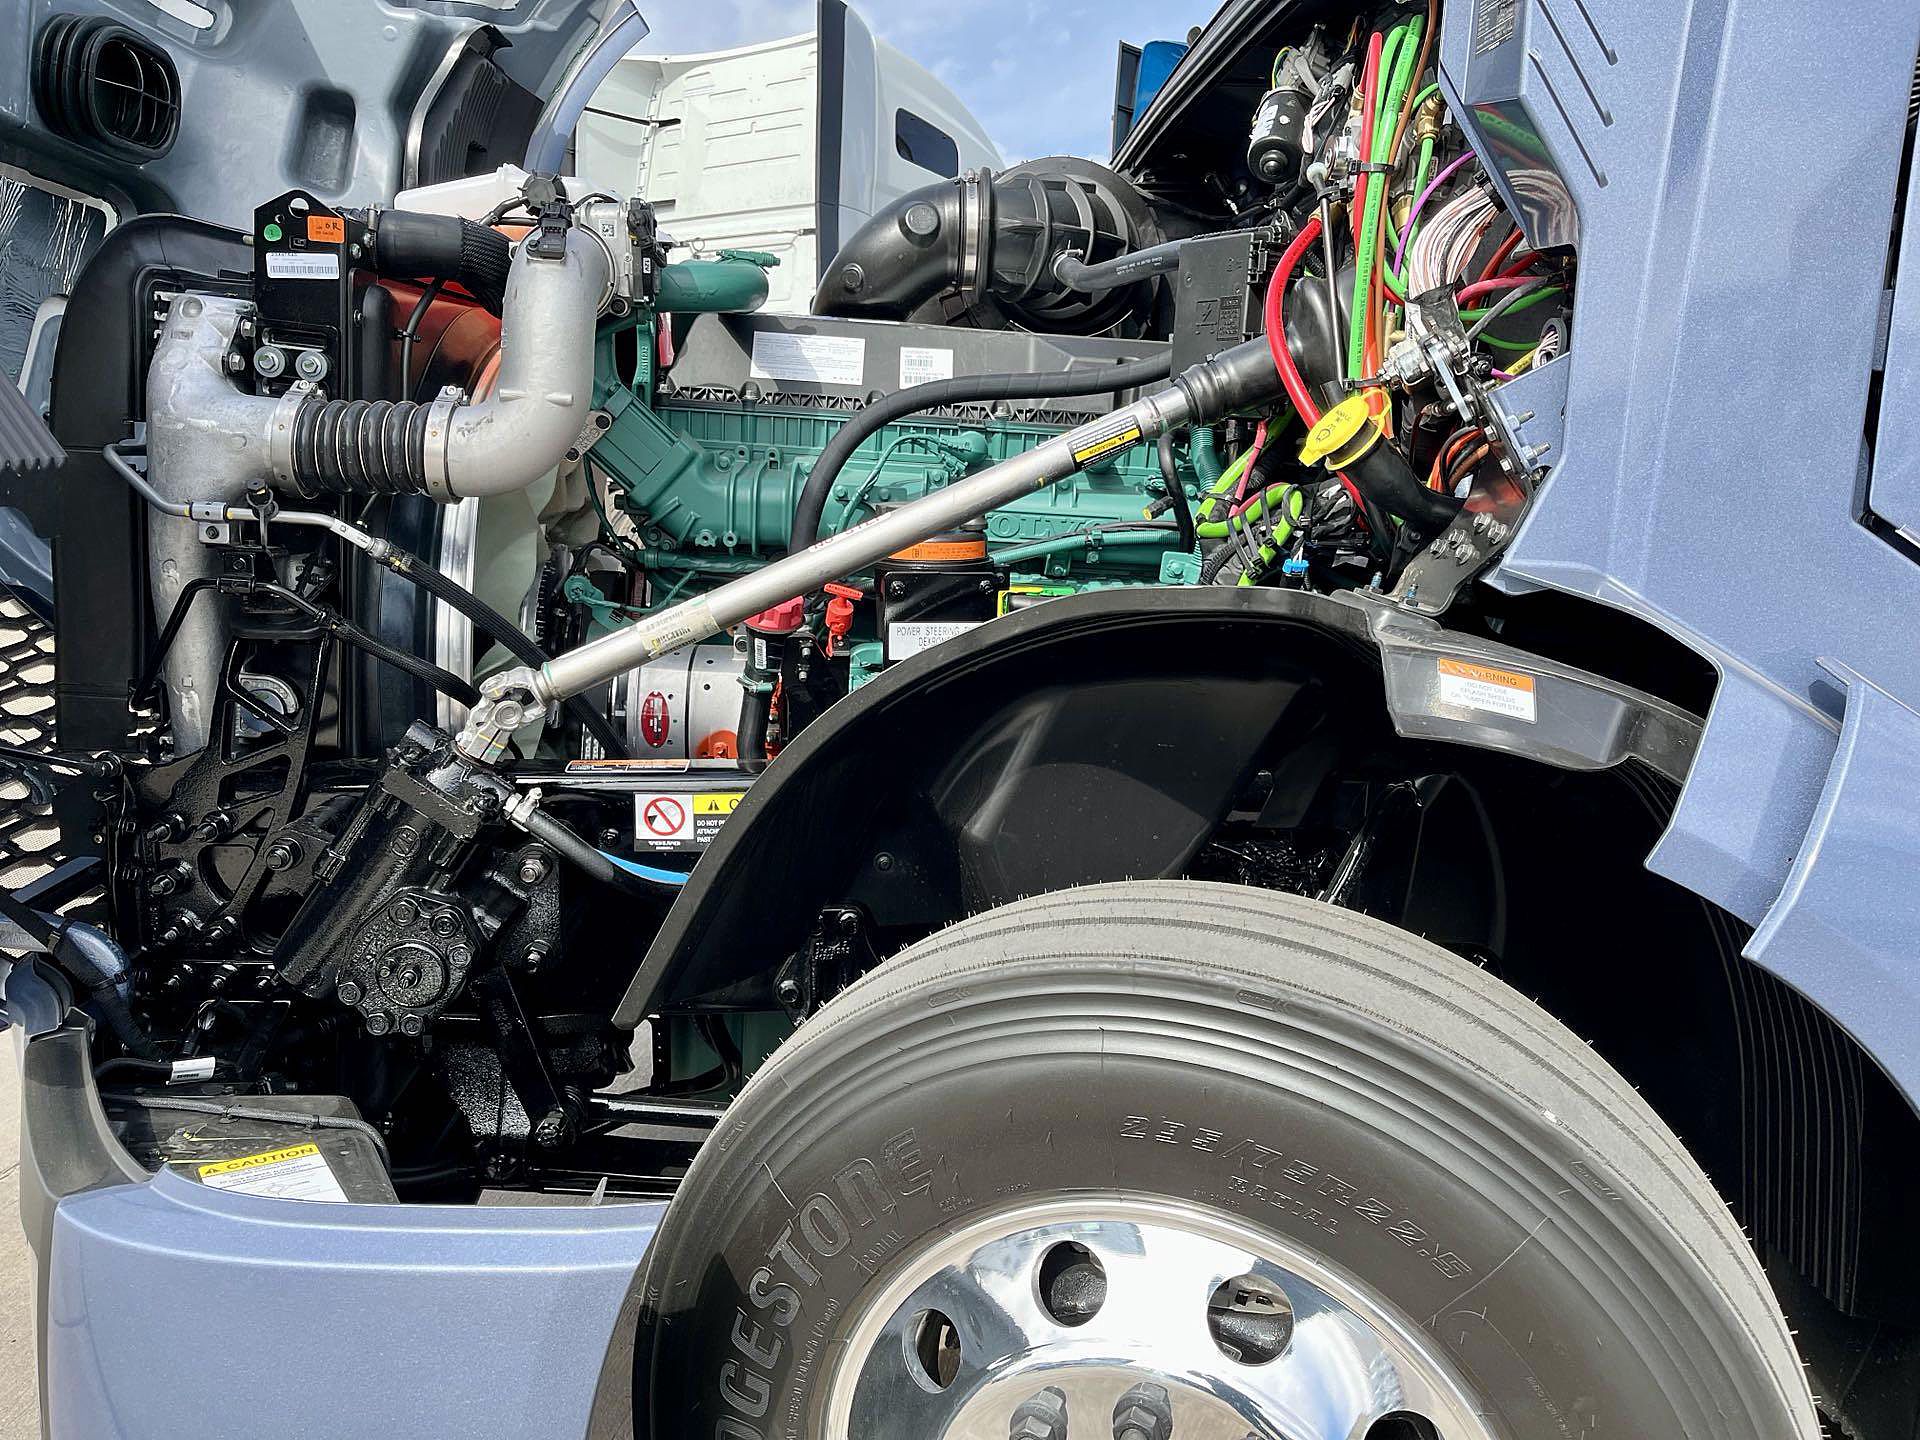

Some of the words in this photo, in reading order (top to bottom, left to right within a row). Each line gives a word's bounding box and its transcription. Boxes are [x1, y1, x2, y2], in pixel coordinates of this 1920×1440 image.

[985, 512, 1104, 541] OLV
[896, 626, 921, 637] POWER
[925, 626, 960, 637] STEERING
[226, 1147, 315, 1170] CAUTION
[862, 1230, 906, 1265] RADIAL
